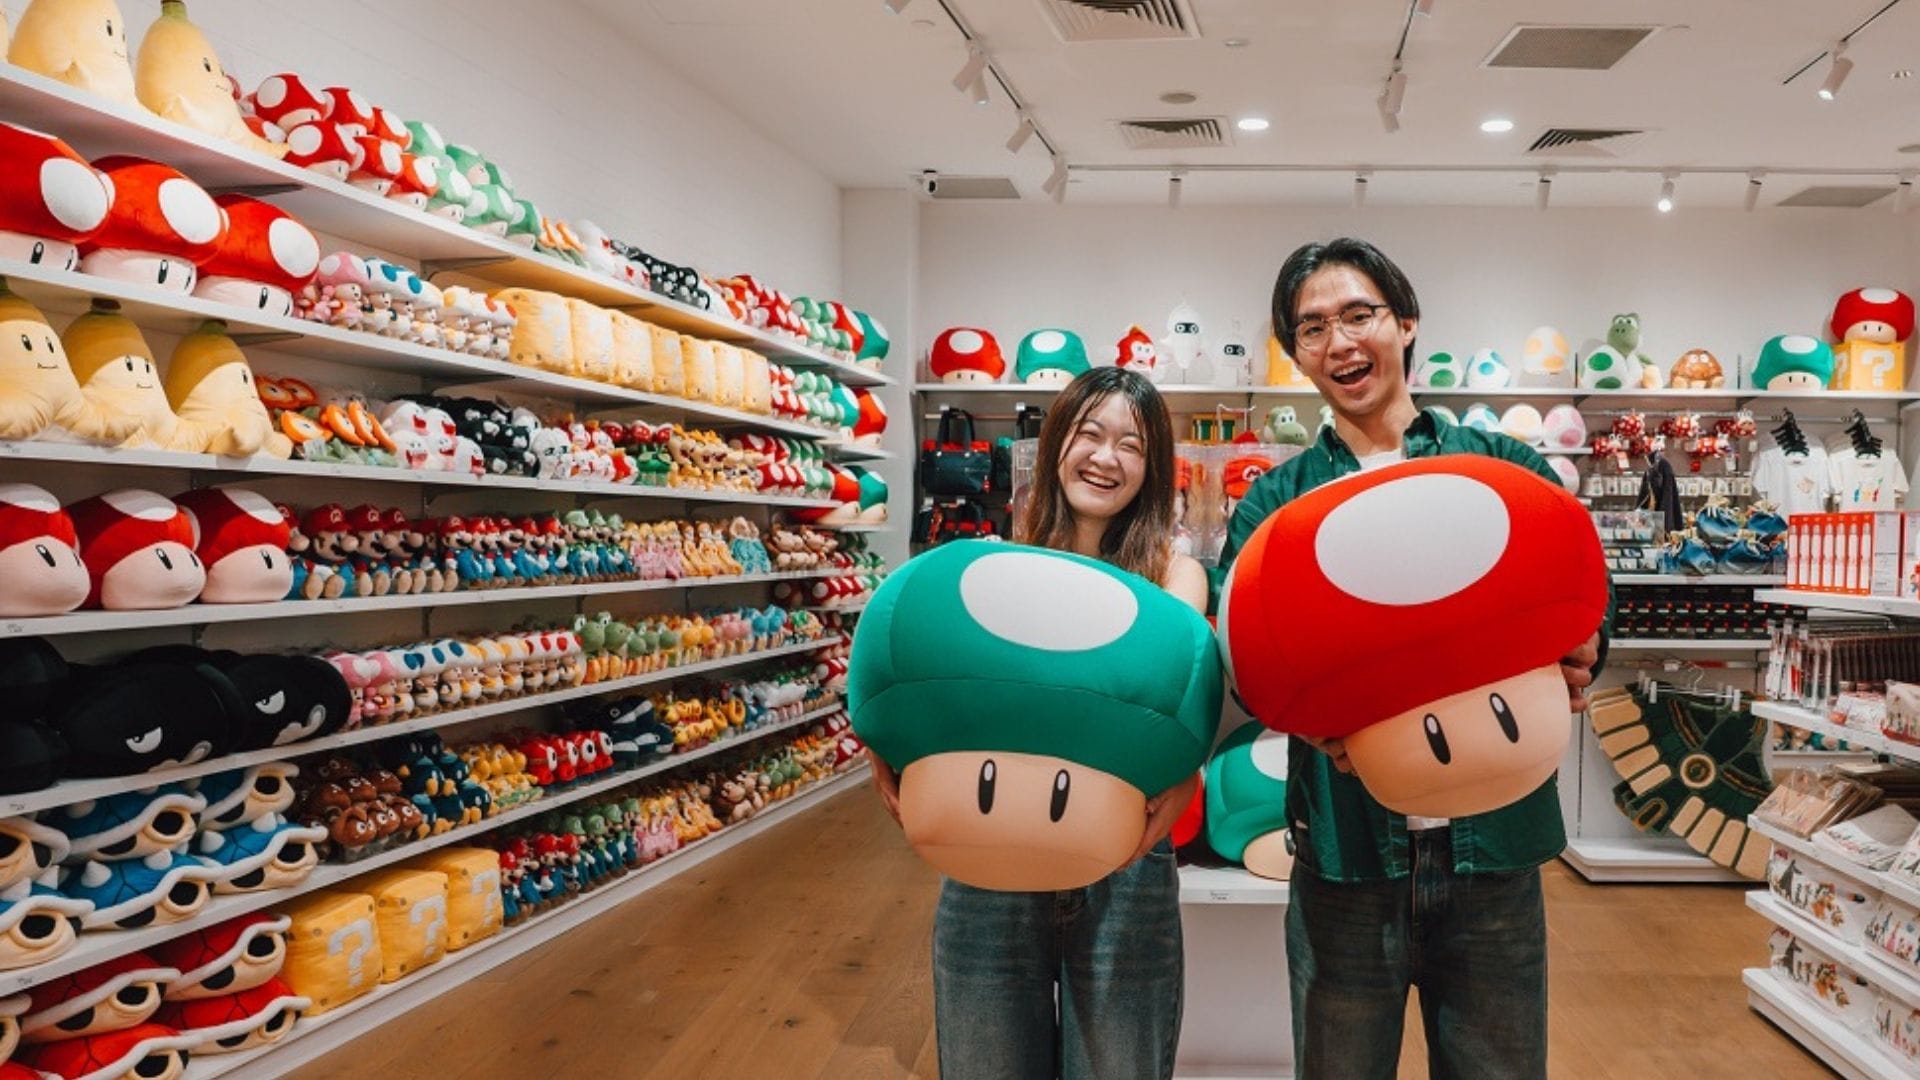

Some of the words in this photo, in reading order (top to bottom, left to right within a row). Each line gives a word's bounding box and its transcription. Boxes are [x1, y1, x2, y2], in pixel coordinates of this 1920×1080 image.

[1861, 350, 1895, 388] ?
[328, 918, 371, 986] ?
[411, 895, 444, 958] ?
